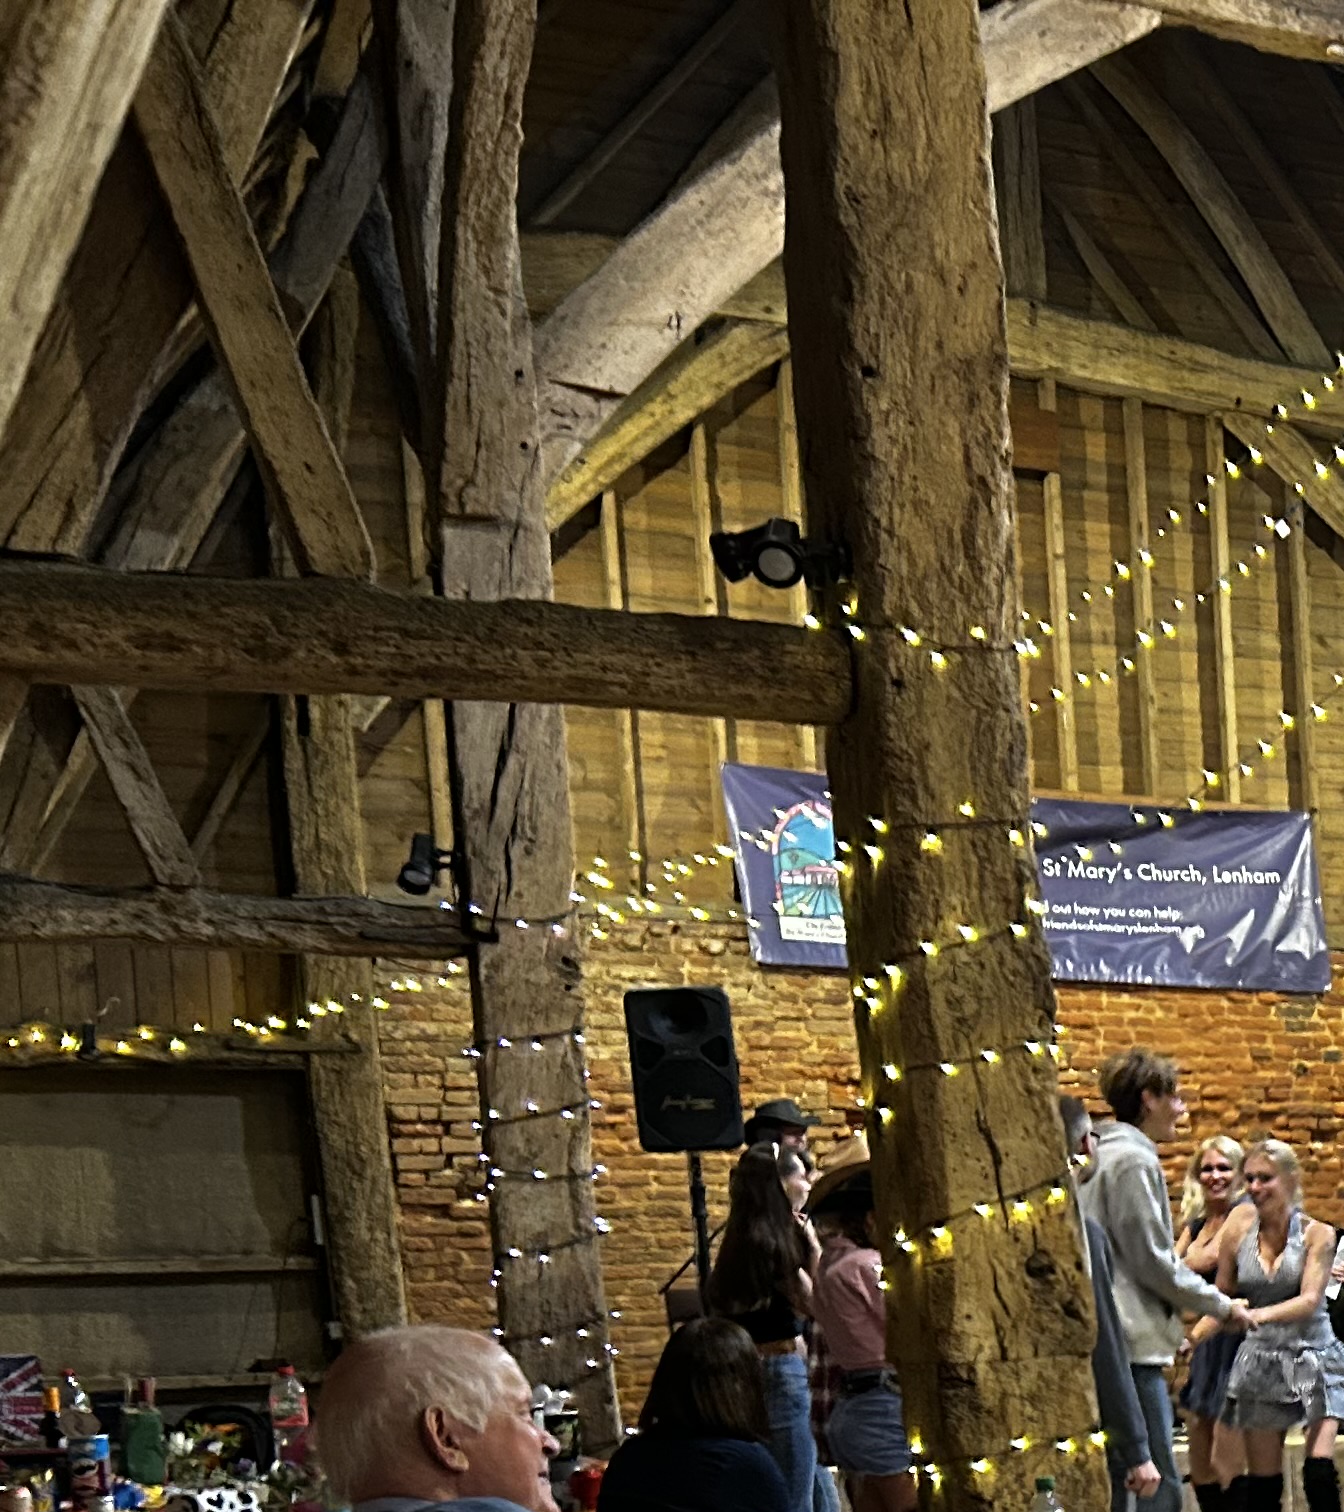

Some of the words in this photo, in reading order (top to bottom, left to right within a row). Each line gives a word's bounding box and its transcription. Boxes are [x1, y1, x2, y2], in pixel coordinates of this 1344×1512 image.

[1042, 858, 1062, 877] St
[1067, 861, 1133, 884] Mary's
[1137, 863, 1207, 886] Church,
[1212, 865, 1281, 885] Lenham
[1074, 901, 1100, 916] how
[1103, 904, 1126, 920] you
[1129, 908, 1152, 919] can
